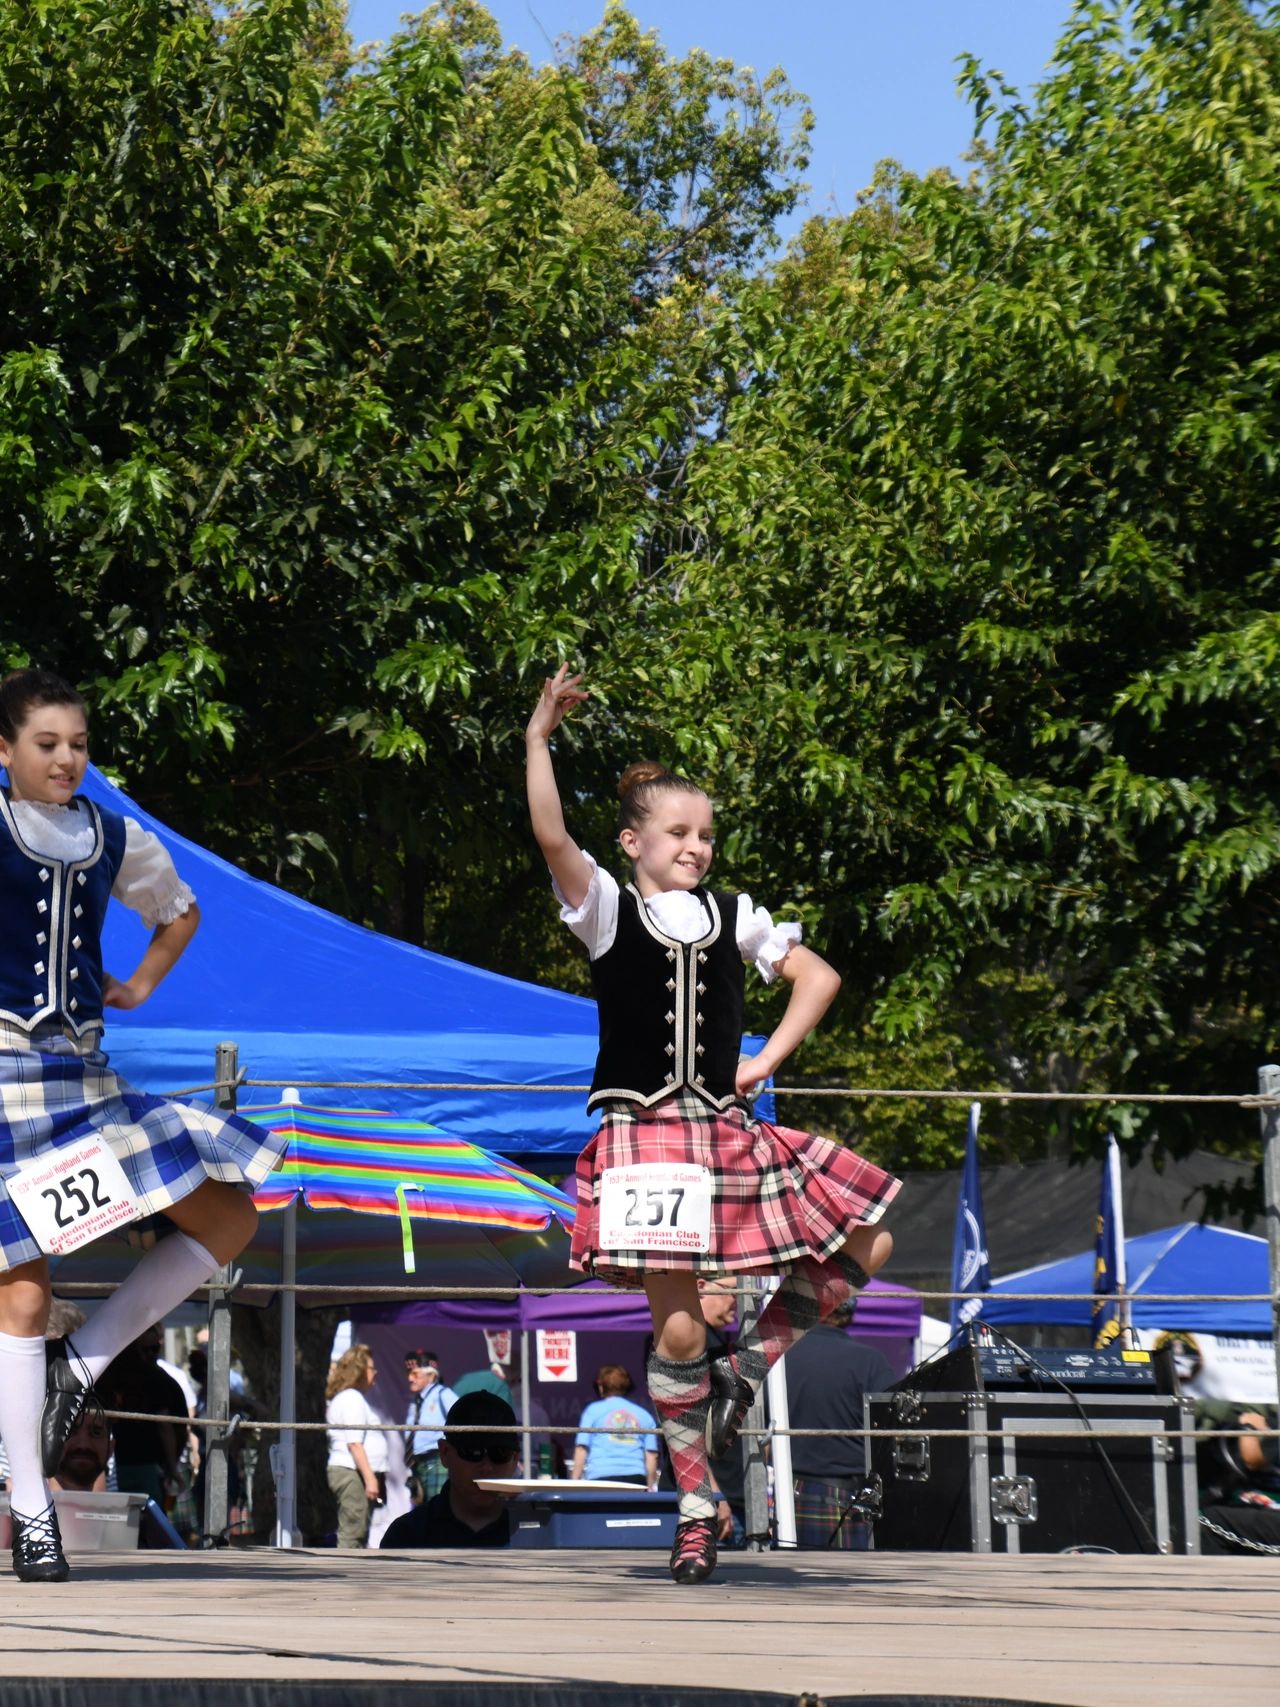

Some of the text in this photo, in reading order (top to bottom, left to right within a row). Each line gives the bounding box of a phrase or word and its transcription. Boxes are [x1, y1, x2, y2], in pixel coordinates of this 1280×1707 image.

[31, 1167, 54, 1185] Annual
[52, 1154, 81, 1174] Highland
[79, 1145, 102, 1160] Games
[679, 1172, 702, 1183] Games
[40, 1168, 112, 1228] 252
[625, 1187, 685, 1227] 257
[49, 1199, 130, 1246] Caledonian Club
[52, 1207, 134, 1254] of San Francisco
[609, 1230, 700, 1239] Cdonian Club
[647, 1237, 701, 1248] Francisco
